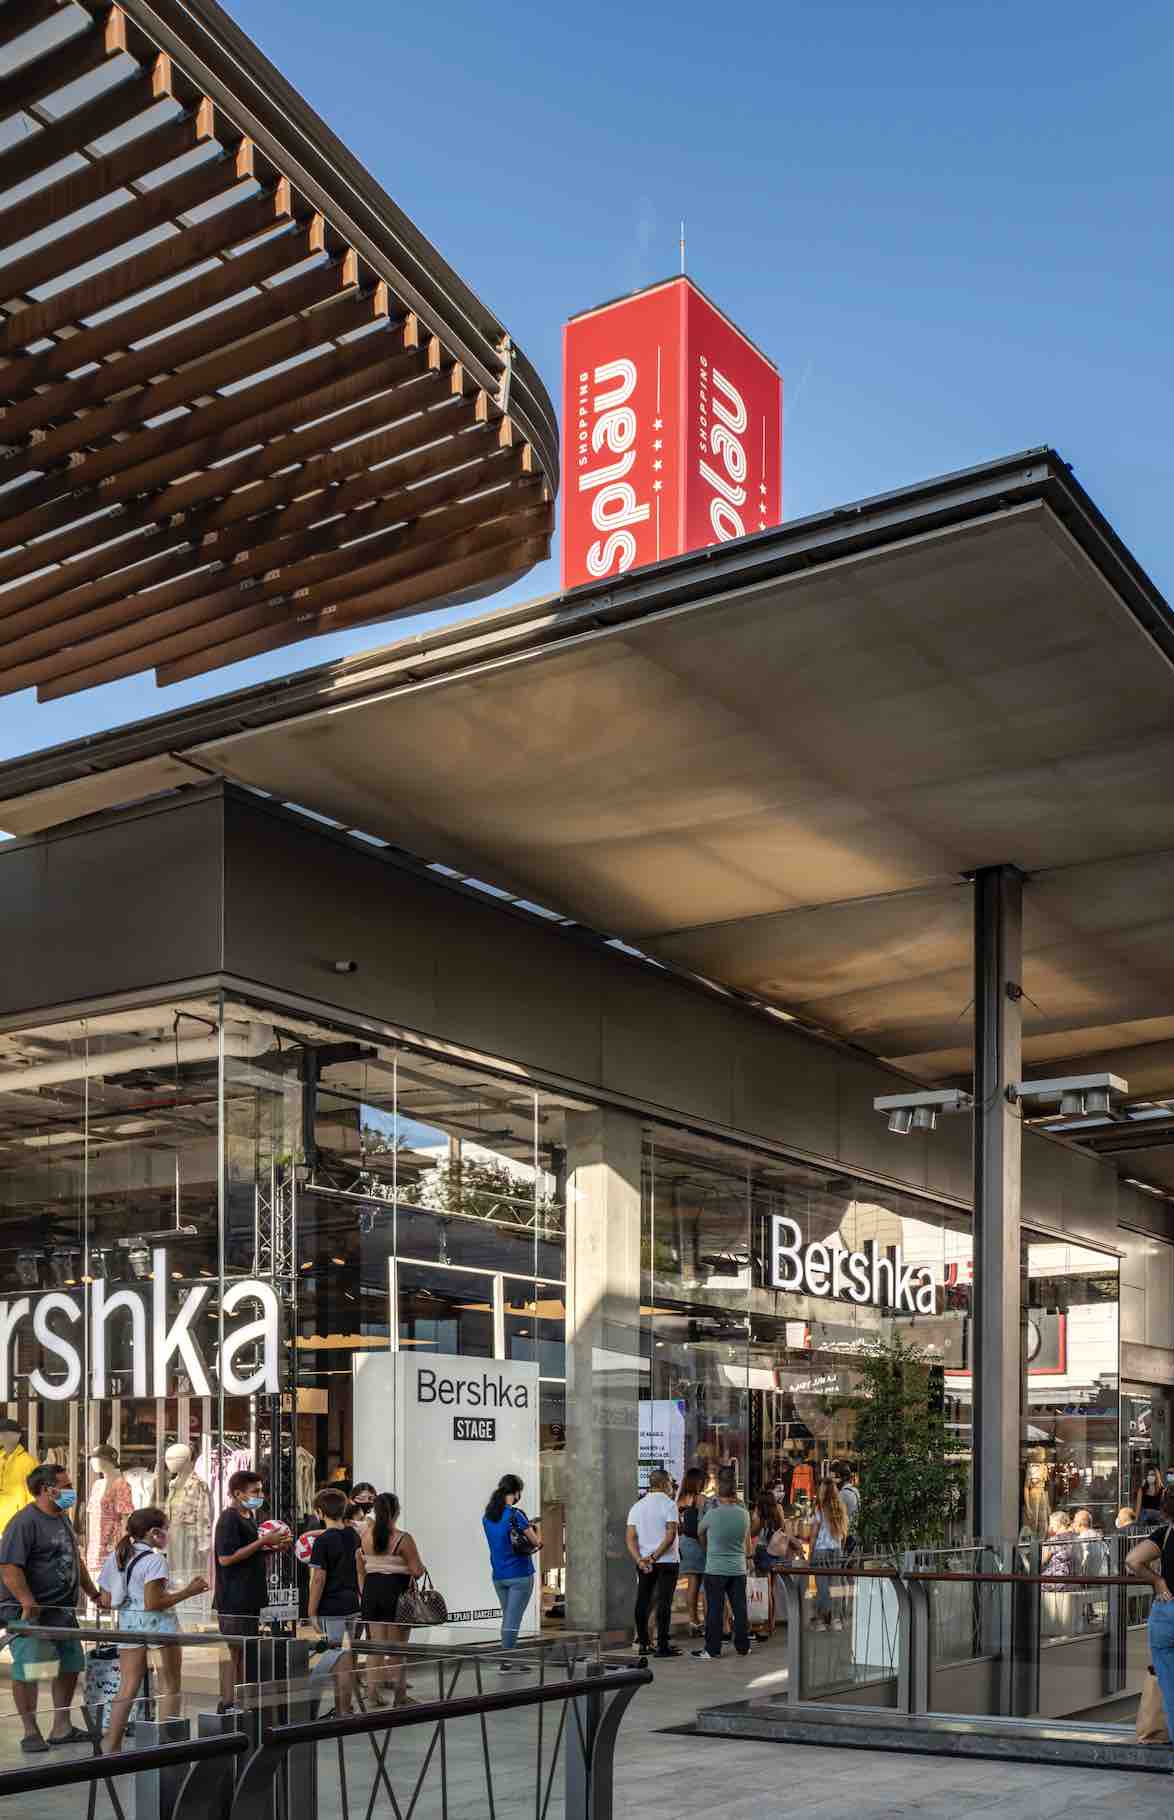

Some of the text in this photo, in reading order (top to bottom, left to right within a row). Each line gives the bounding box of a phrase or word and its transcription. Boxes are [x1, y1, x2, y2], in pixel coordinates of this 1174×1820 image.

[578, 372, 588, 465] SHOPPING
[699, 355, 707, 453] SHOPPING
[578, 358, 650, 577] splau
[699, 367, 748, 547] plau
[771, 1215, 937, 1315] Bershka
[417, 1368, 528, 1408] Bershka
[456, 1420, 493, 1439] STAGE
